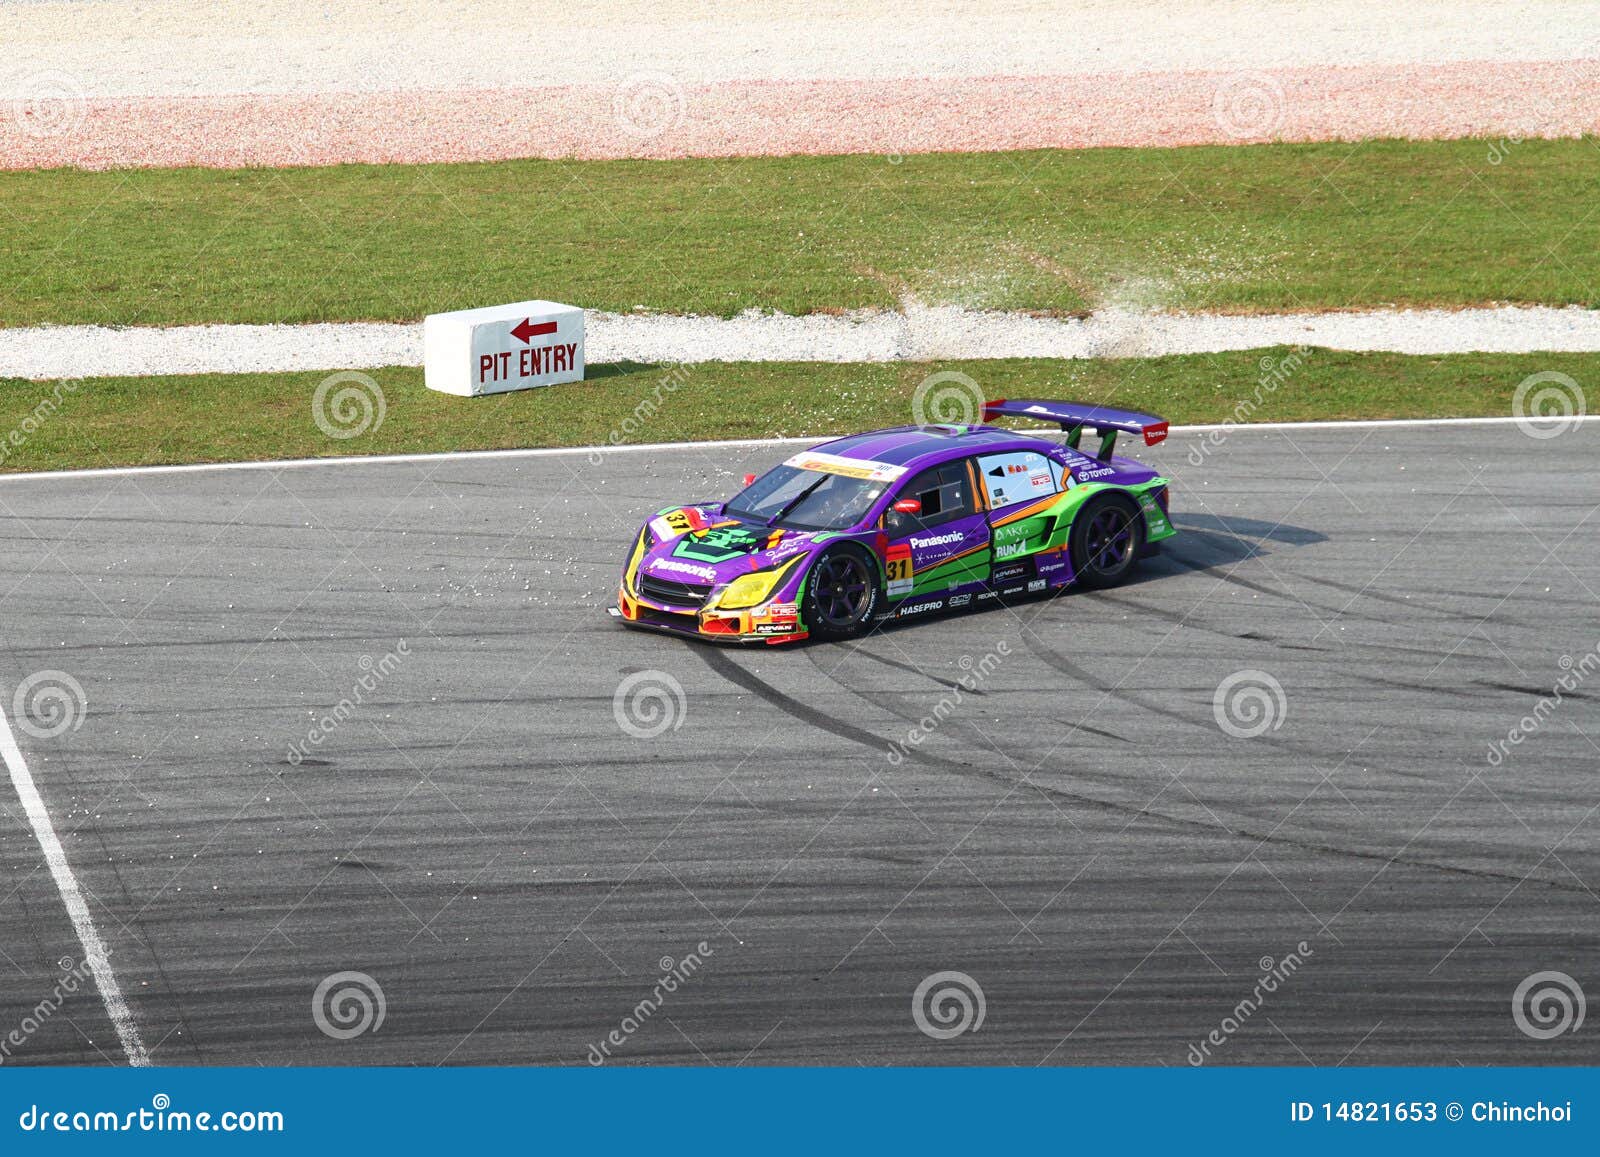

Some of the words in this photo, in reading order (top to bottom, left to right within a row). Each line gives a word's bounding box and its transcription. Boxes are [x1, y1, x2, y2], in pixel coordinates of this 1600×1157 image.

[480, 352, 512, 383] PIT
[519, 342, 577, 378] ENTRY
[1146, 429, 1167, 439] TOTAL
[1088, 467, 1116, 479] TOYOTA
[666, 513, 691, 530] 31
[909, 530, 964, 550] Panasonic
[649, 557, 717, 580] Panasonic
[886, 559, 907, 581] 31
[900, 600, 944, 616] HASEPRO
